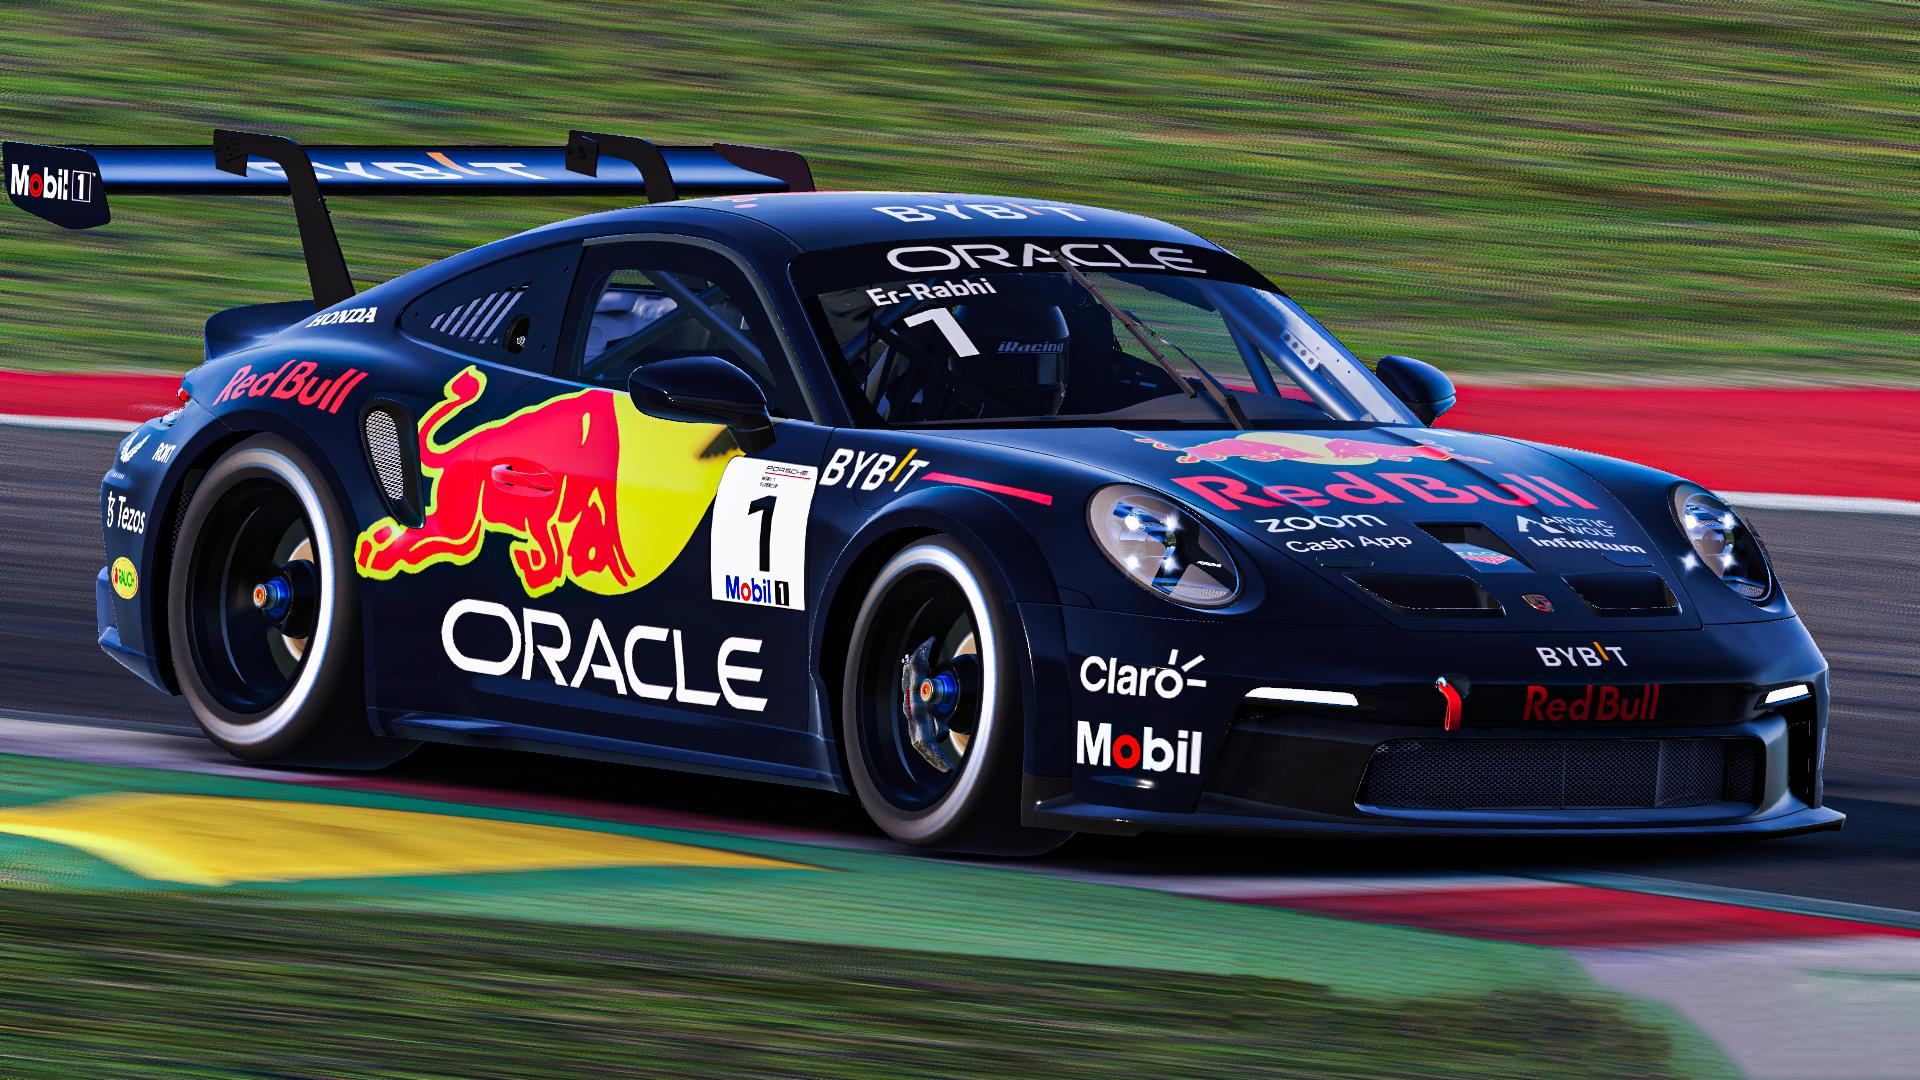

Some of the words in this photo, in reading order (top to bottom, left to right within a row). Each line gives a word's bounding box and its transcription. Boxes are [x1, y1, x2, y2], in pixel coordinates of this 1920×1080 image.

[10, 163, 69, 200] Mobil
[872, 202, 1087, 222] BYBIT
[886, 243, 1207, 273] ORACLE
[865, 277, 997, 307] Er-Rabhi
[305, 306, 378, 328] HONDA
[903, 307, 980, 358] 1
[212, 359, 297, 406] Red
[270, 361, 369, 415] Bull
[766, 465, 809, 476] PORSCHE
[818, 447, 931, 493] BYBIT
[1170, 471, 1405, 510] Red
[1374, 472, 1600, 510] Bull
[117, 495, 146, 535] Tezos
[1254, 514, 1389, 533] zoom
[1541, 516, 1614, 529] ARCTIC
[1559, 524, 1616, 538] WOLF
[747, 495, 778, 573] 1
[1285, 537, 1355, 553] Cash
[1356, 535, 1413, 549] App
[725, 574, 772, 604] Mobil
[441, 597, 768, 711] ORACLE
[1535, 641, 1629, 667] BYBIT
[1080, 653, 1188, 699] Claro
[1523, 684, 1594, 721] Red
[1596, 683, 1660, 721] Bull
[1076, 720, 1203, 775] Mobil
